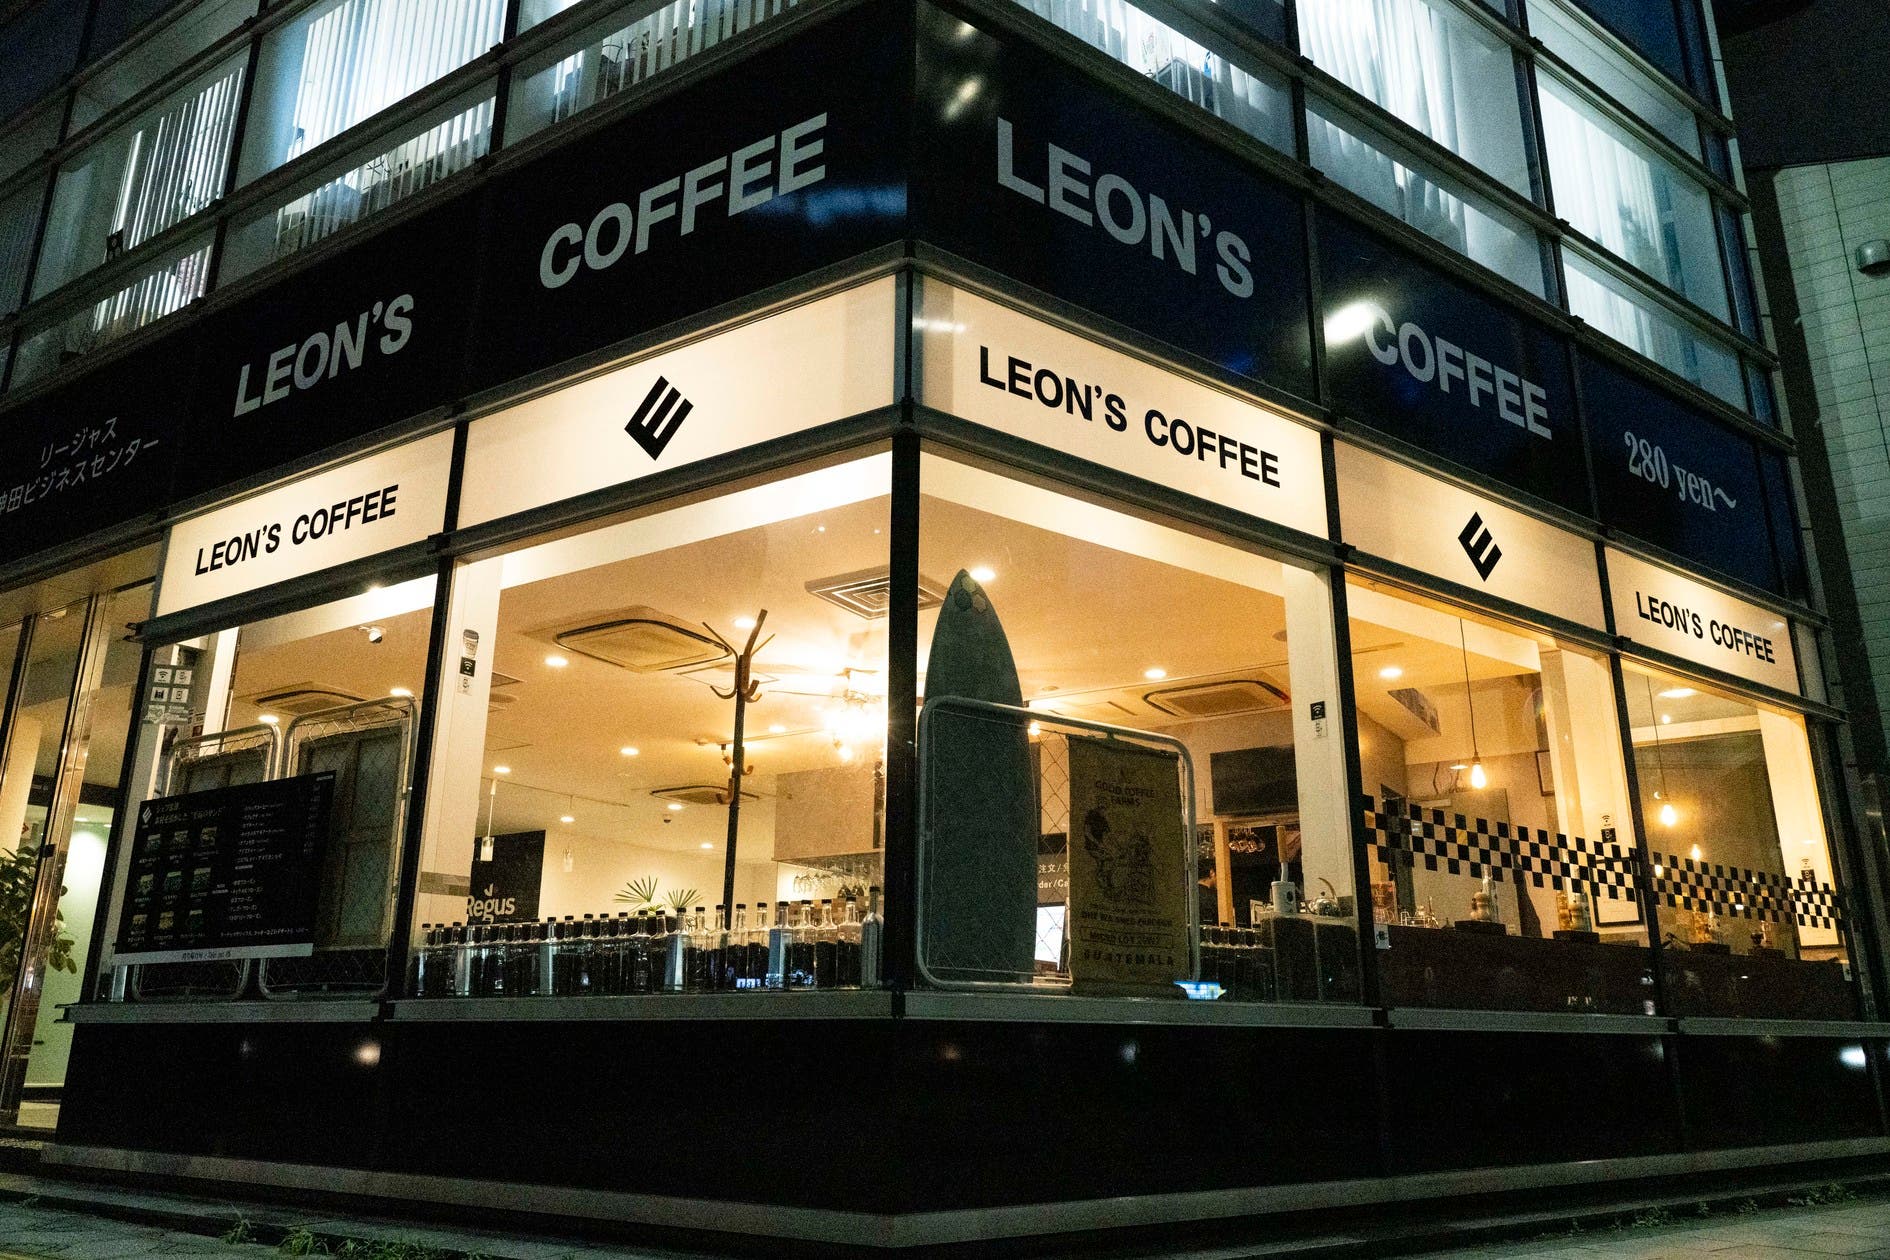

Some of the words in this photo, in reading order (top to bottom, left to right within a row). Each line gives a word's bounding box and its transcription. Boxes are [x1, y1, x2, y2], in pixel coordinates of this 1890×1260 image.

[233, 293, 414, 417] LEON'S
[539, 112, 828, 289] COFFEE
[997, 117, 1254, 298] LEON'S
[1364, 300, 1553, 440] COFFEE
[40, 417, 118, 469] リージャス
[979, 346, 1127, 432] LEON'S
[1145, 409, 1280, 488] COFFEE
[1624, 431, 1670, 485] 280
[195, 523, 281, 576] LEON'S
[292, 484, 399, 545] COFFEE
[1636, 591, 1704, 640] LEON'S
[1710, 623, 1776, 665] COFFEE
[467, 894, 516, 924] Regus
